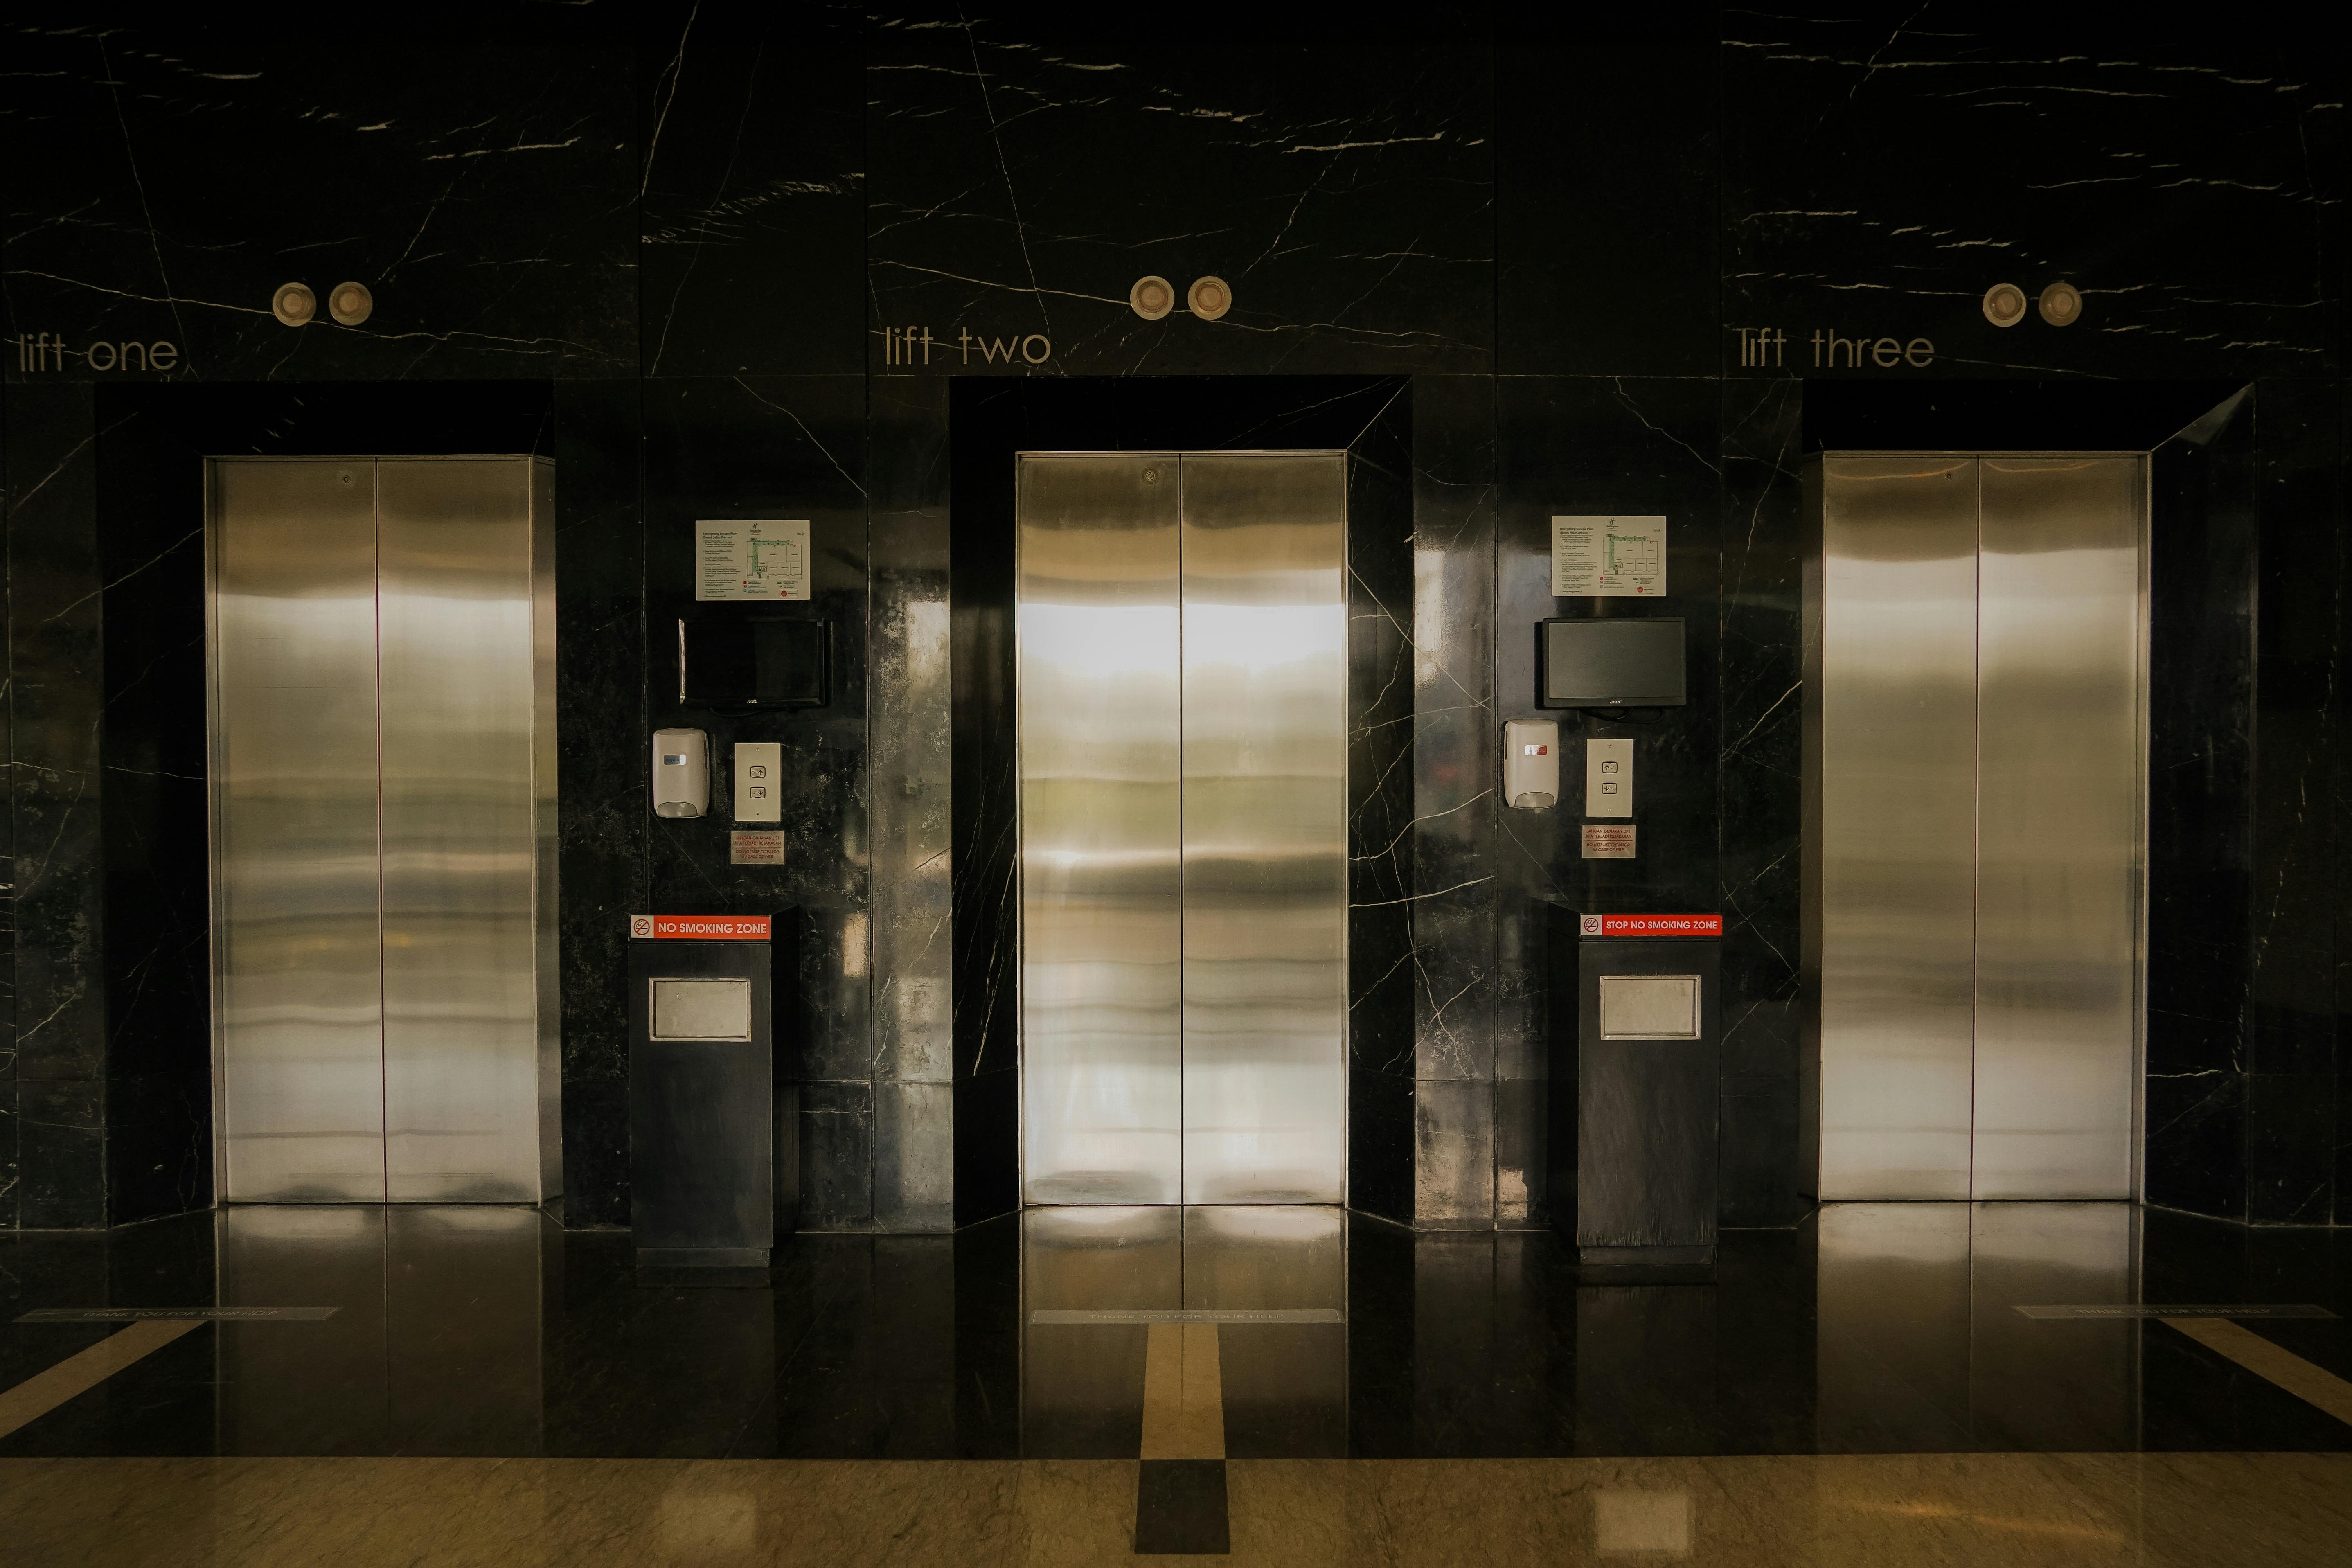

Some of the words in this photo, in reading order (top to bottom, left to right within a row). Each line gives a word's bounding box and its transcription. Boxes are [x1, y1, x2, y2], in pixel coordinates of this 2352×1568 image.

[19, 332, 66, 372] lift
[88, 340, 178, 372] one
[886, 327, 934, 365] lift
[959, 327, 1051, 365] two
[1741, 328, 1787, 367] lift
[1811, 329, 1935, 367] three
[658, 923, 676, 933] NO
[679, 923, 734, 933] SMOKING
[737, 924, 766, 933] ZONE
[1648, 921, 1691, 929] SMOKING
